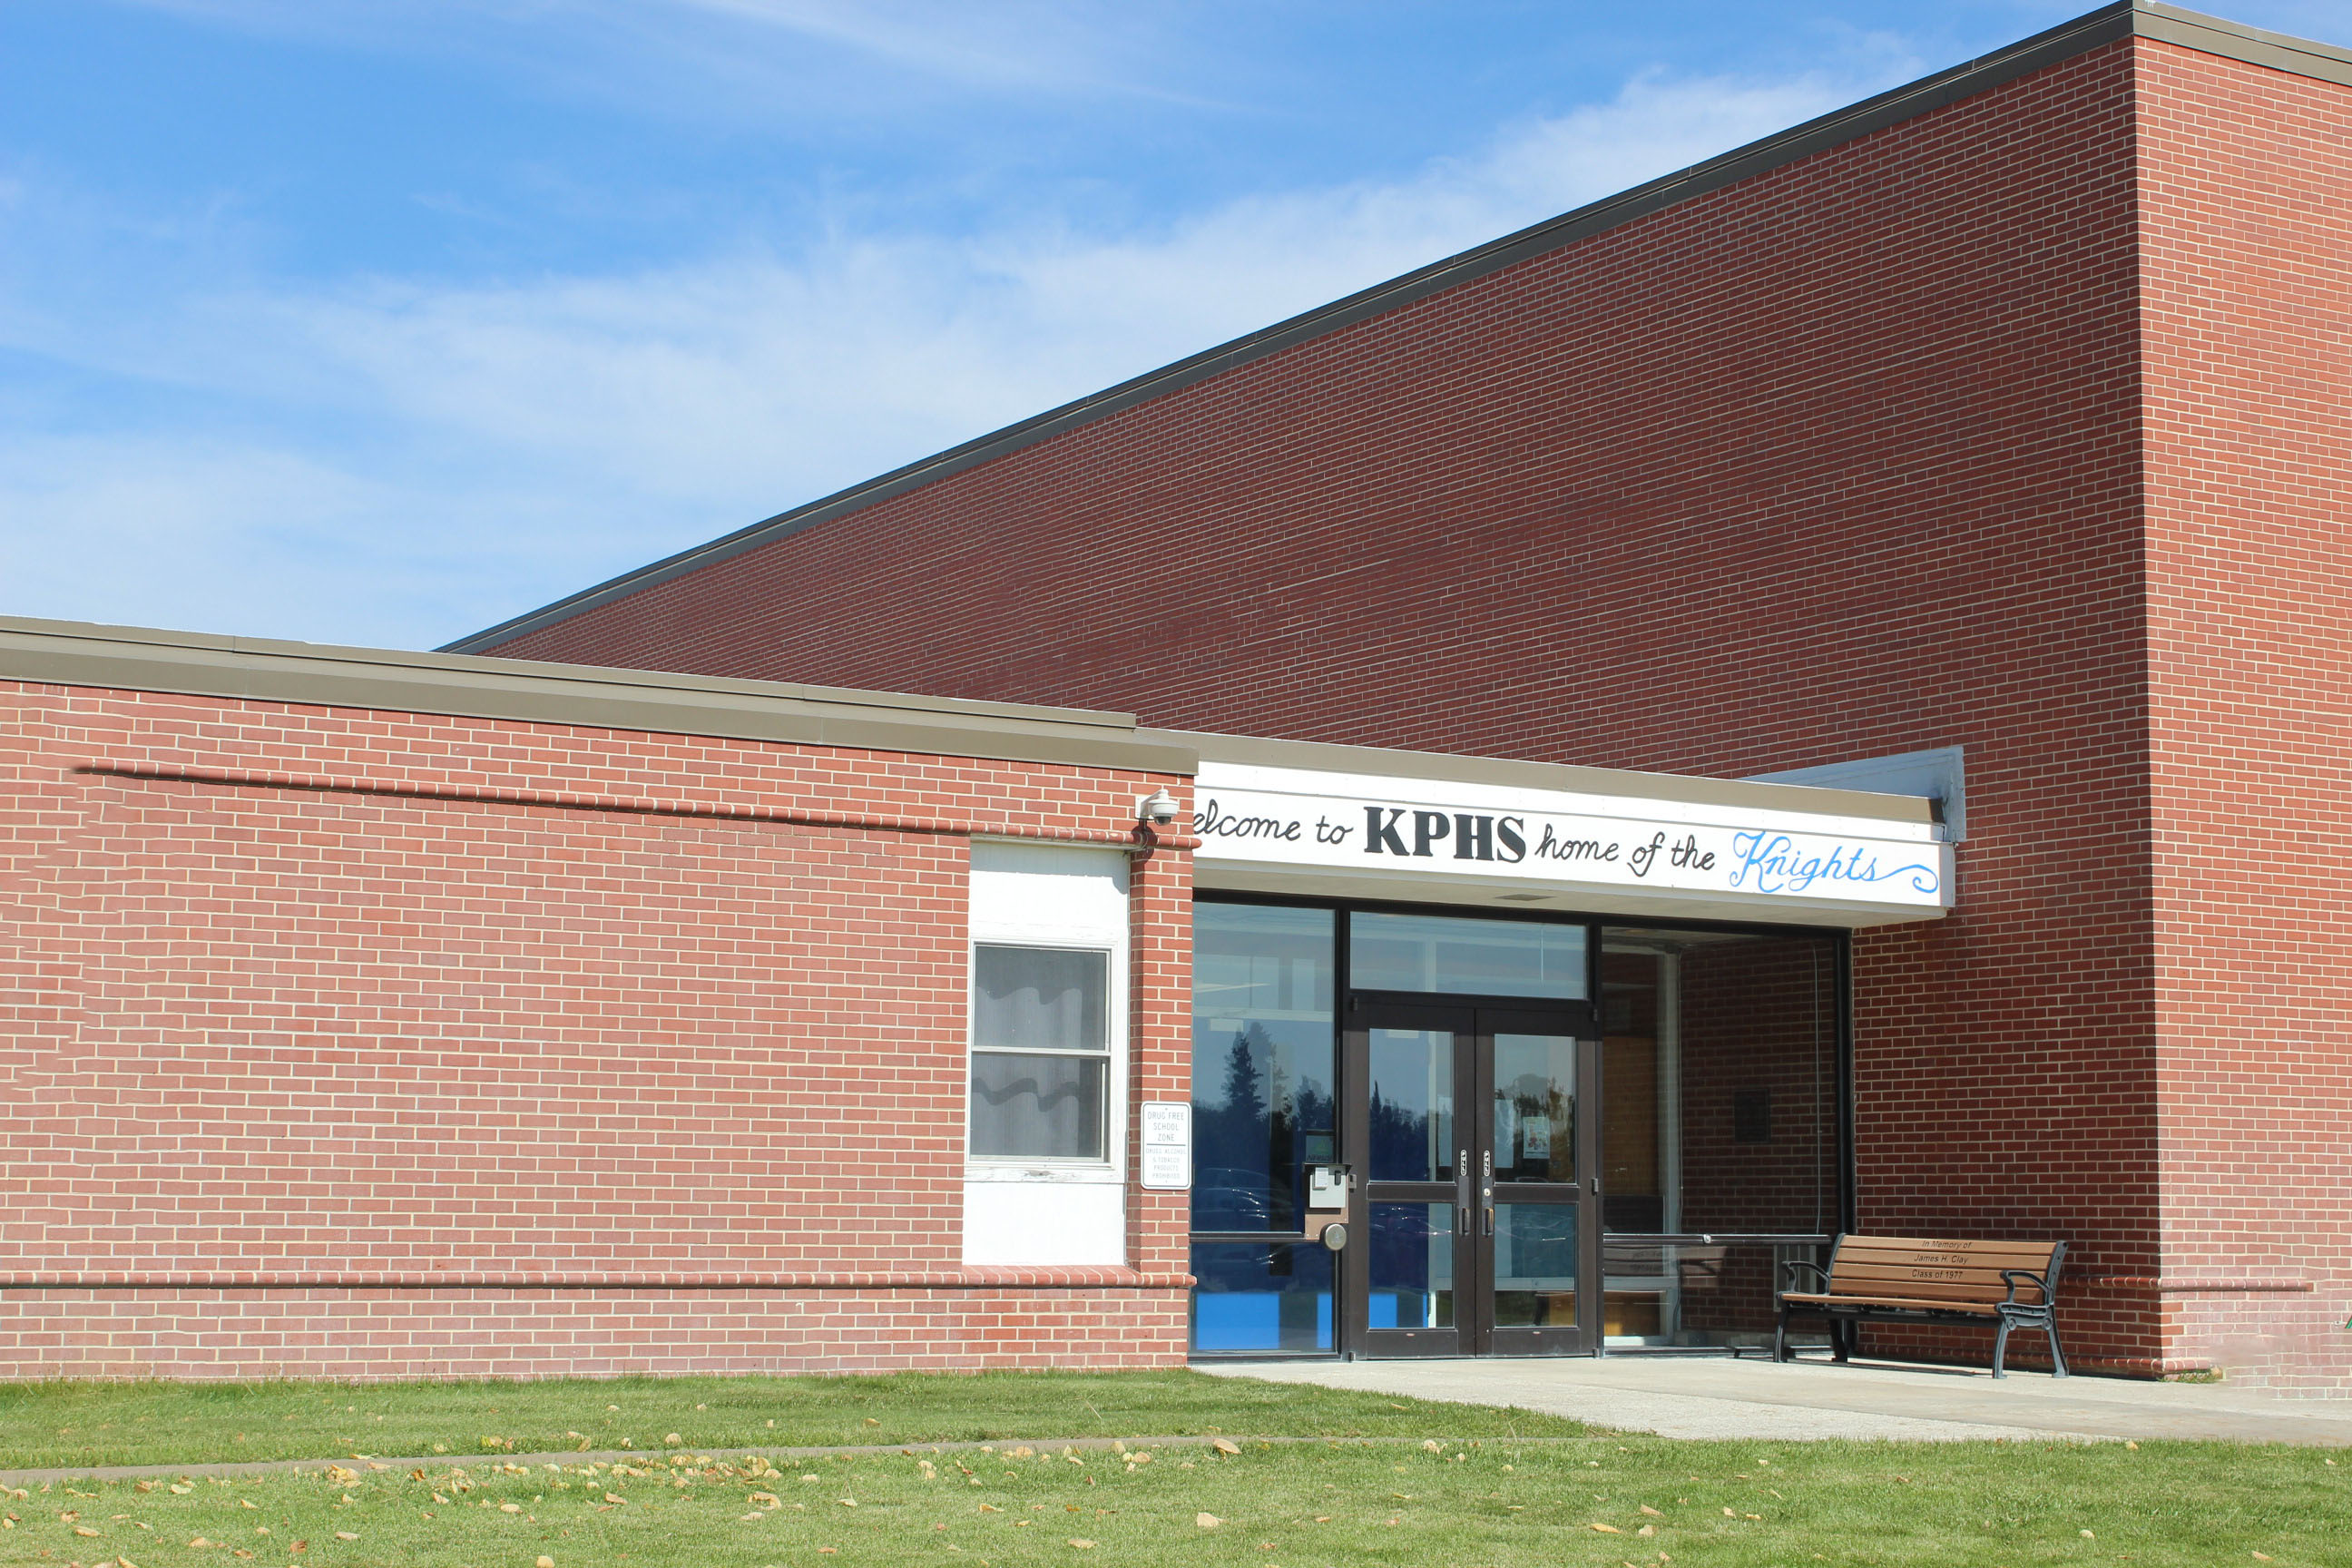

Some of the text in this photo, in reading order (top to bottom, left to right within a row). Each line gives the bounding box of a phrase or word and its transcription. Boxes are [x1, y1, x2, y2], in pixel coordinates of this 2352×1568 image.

[1193, 798, 1939, 894] elcome to KPHS home of the Knights
[1147, 1111, 1184, 1121] DRUG FREE
[1153, 1122, 1179, 1131] SCHOOL
[1157, 1133, 1175, 1142] ZONE
[1931, 1240, 1961, 1250] Memory
[1914, 1253, 1939, 1262] James
[1951, 1255, 1969, 1265] Clay
[1911, 1269, 1964, 1279] Class of 1977
